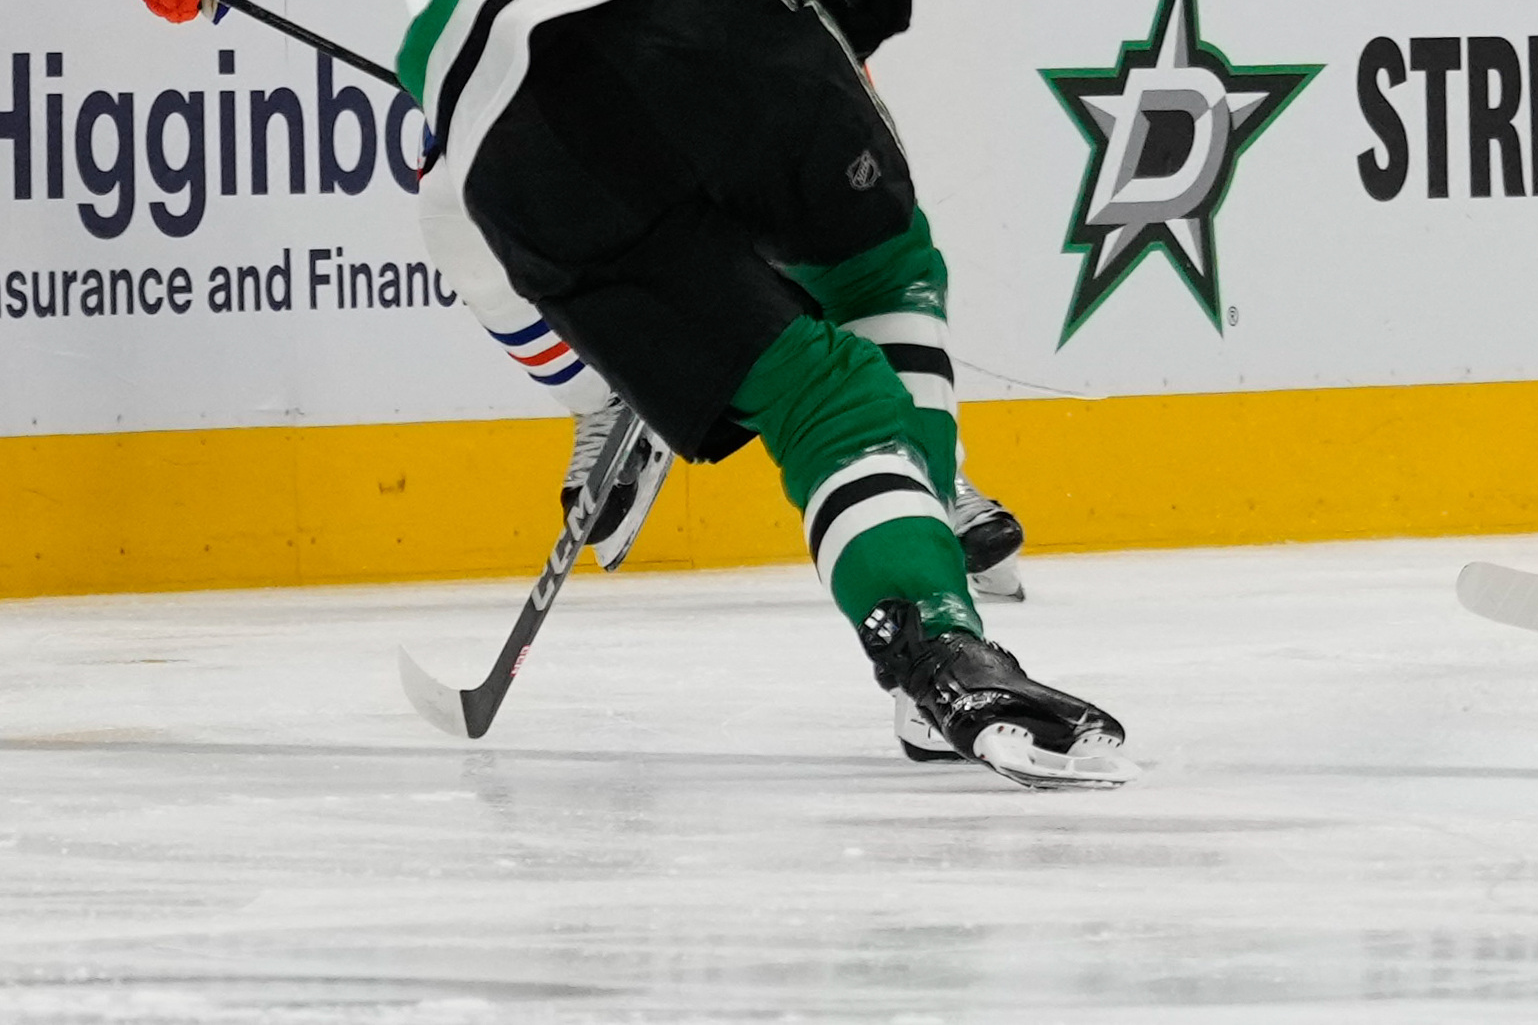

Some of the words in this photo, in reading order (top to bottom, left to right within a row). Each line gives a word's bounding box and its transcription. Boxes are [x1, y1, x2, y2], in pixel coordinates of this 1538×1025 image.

[0, 269, 193, 319] surance
[208, 247, 291, 315] and
[309, 245, 468, 311] Financ
